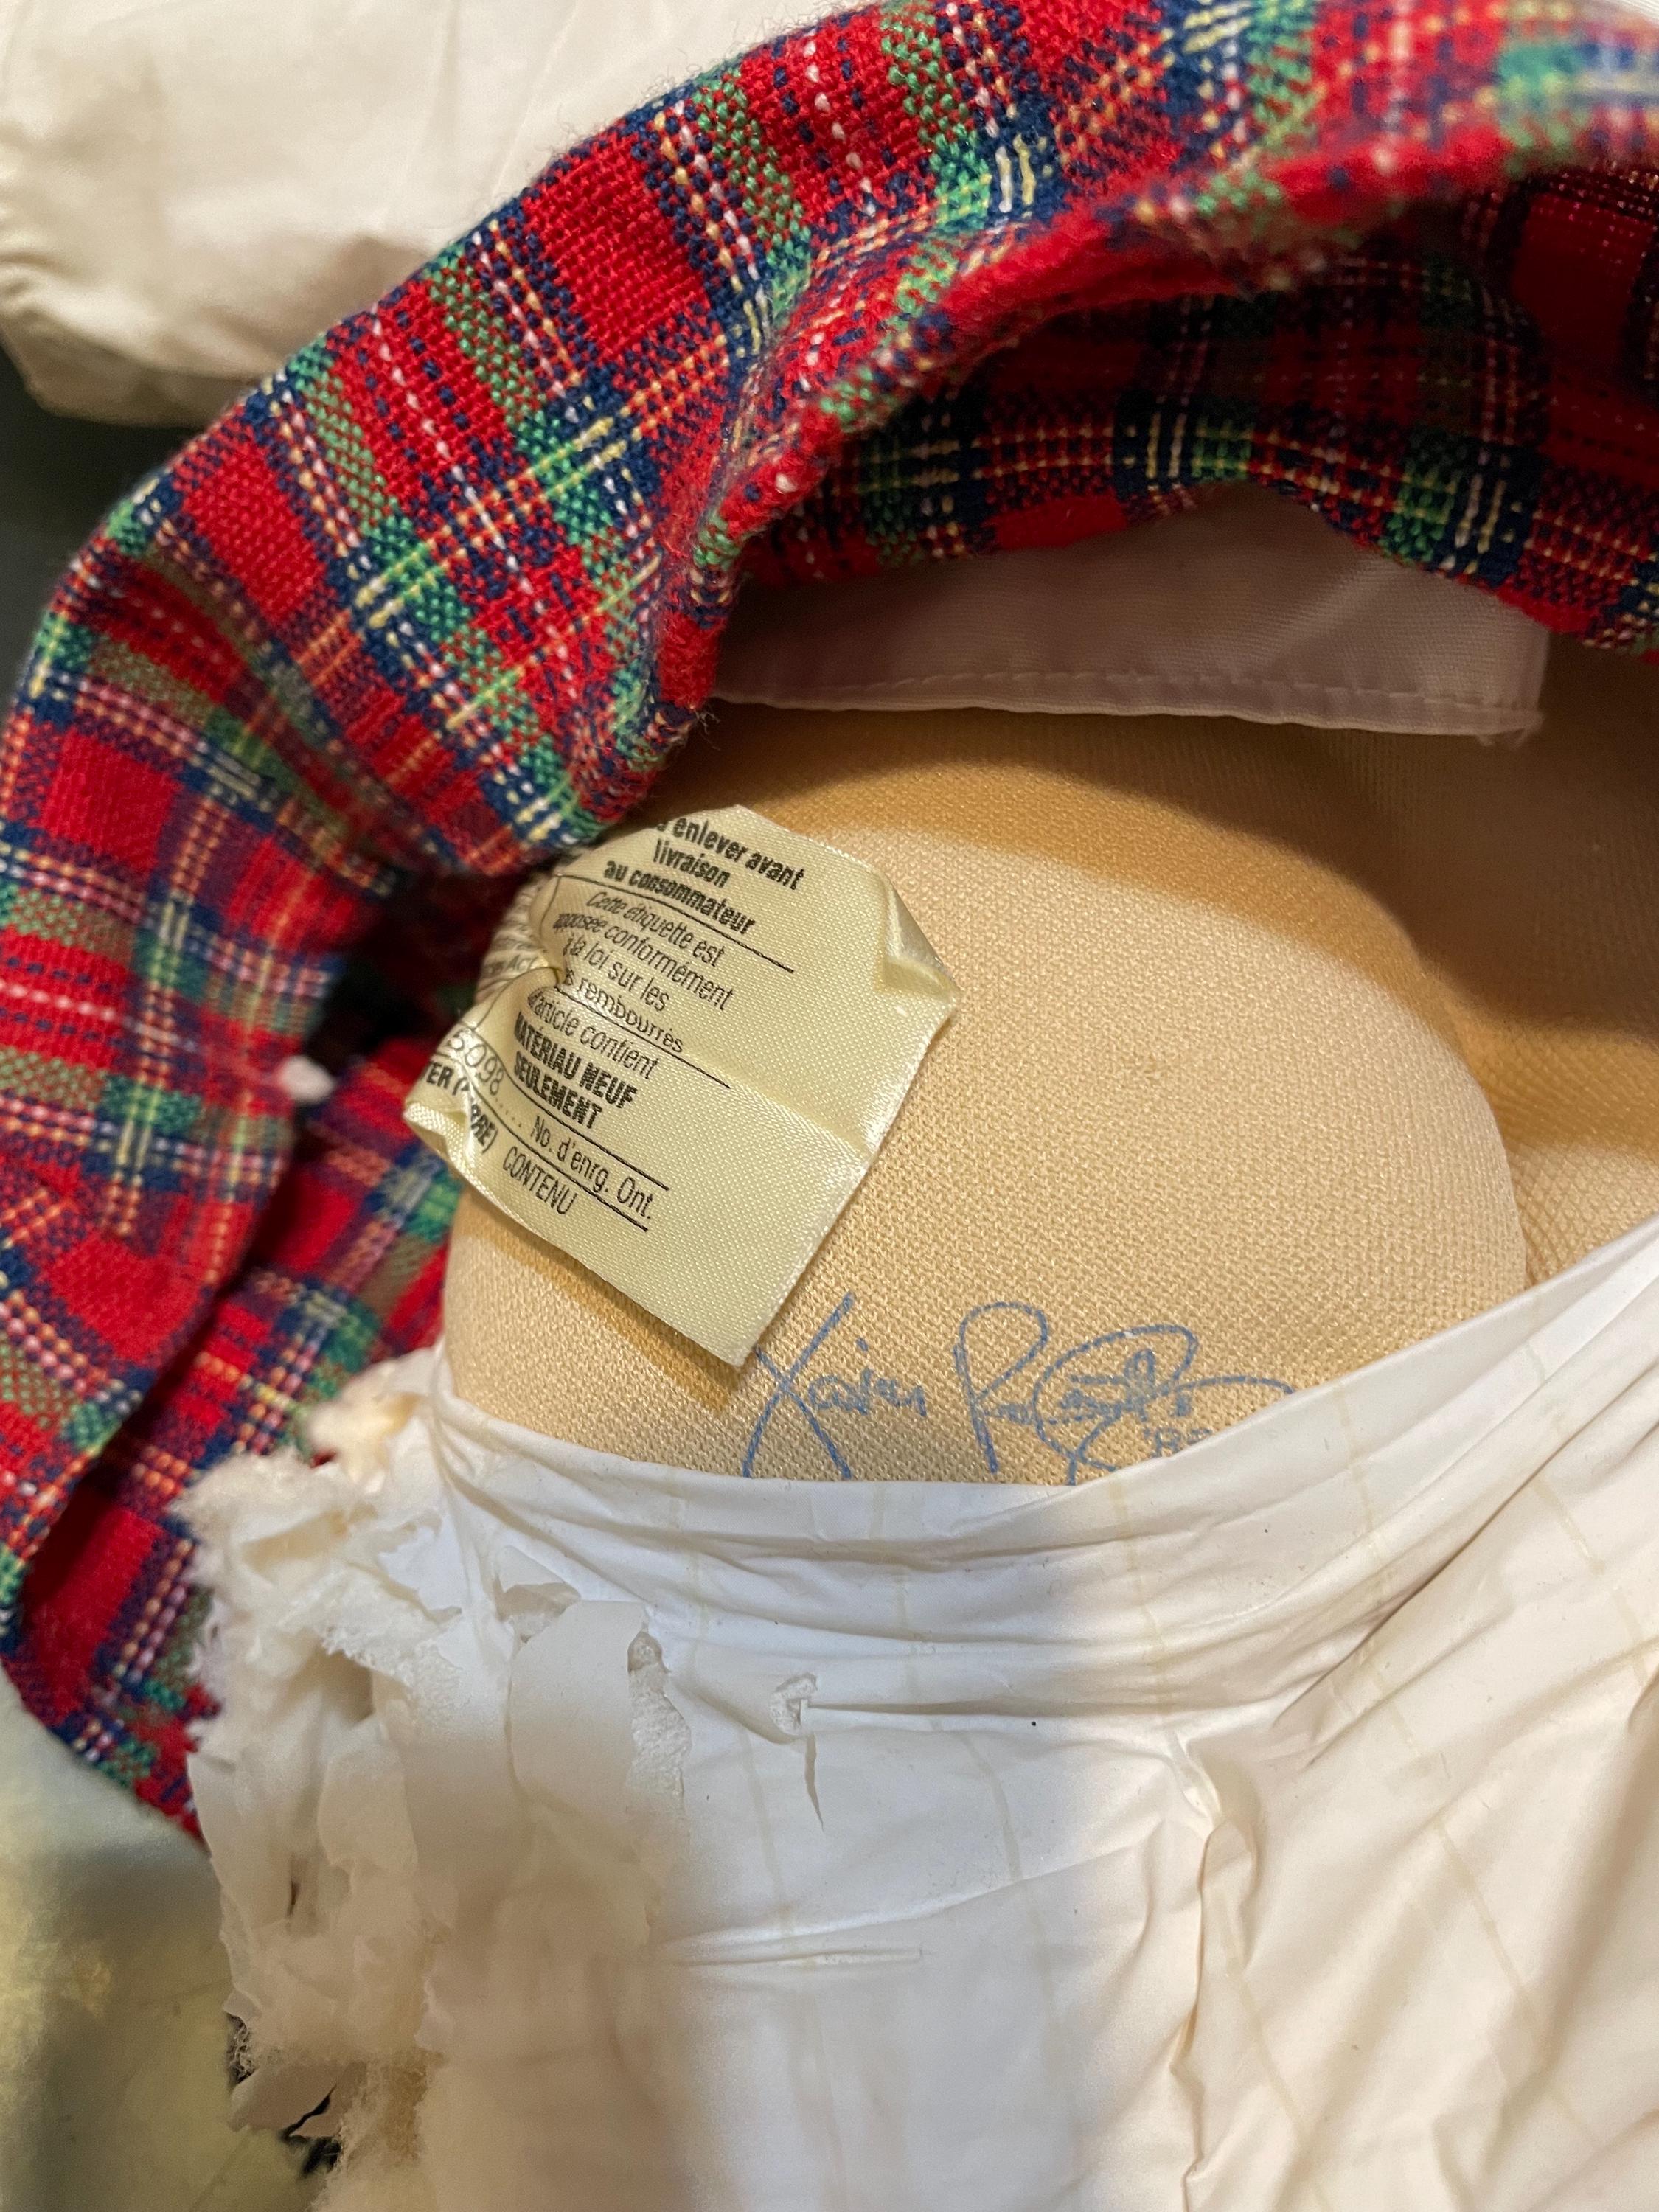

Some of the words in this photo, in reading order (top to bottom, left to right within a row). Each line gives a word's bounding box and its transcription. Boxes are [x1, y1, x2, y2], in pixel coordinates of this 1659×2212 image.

[653, 838, 731, 888] livraison
[672, 817, 748, 863] enlever
[745, 850, 804, 891] avant
[586, 891, 628, 915] Cette
[692, 939, 726, 967] est
[603, 860, 629, 883] au
[628, 869, 757, 935] consommateur
[583, 940, 615, 970] loi
[607, 960, 644, 992] sur
[639, 976, 669, 1012] les
[603, 925, 734, 1011] conformément
[577, 976, 684, 1053] rembourrés
[579, 1061, 637, 1108] NEUF
[580, 1025, 659, 1079] contient
[502, 1146, 578, 1215] CONTENU
[616, 1175, 654, 1220] Ont.
